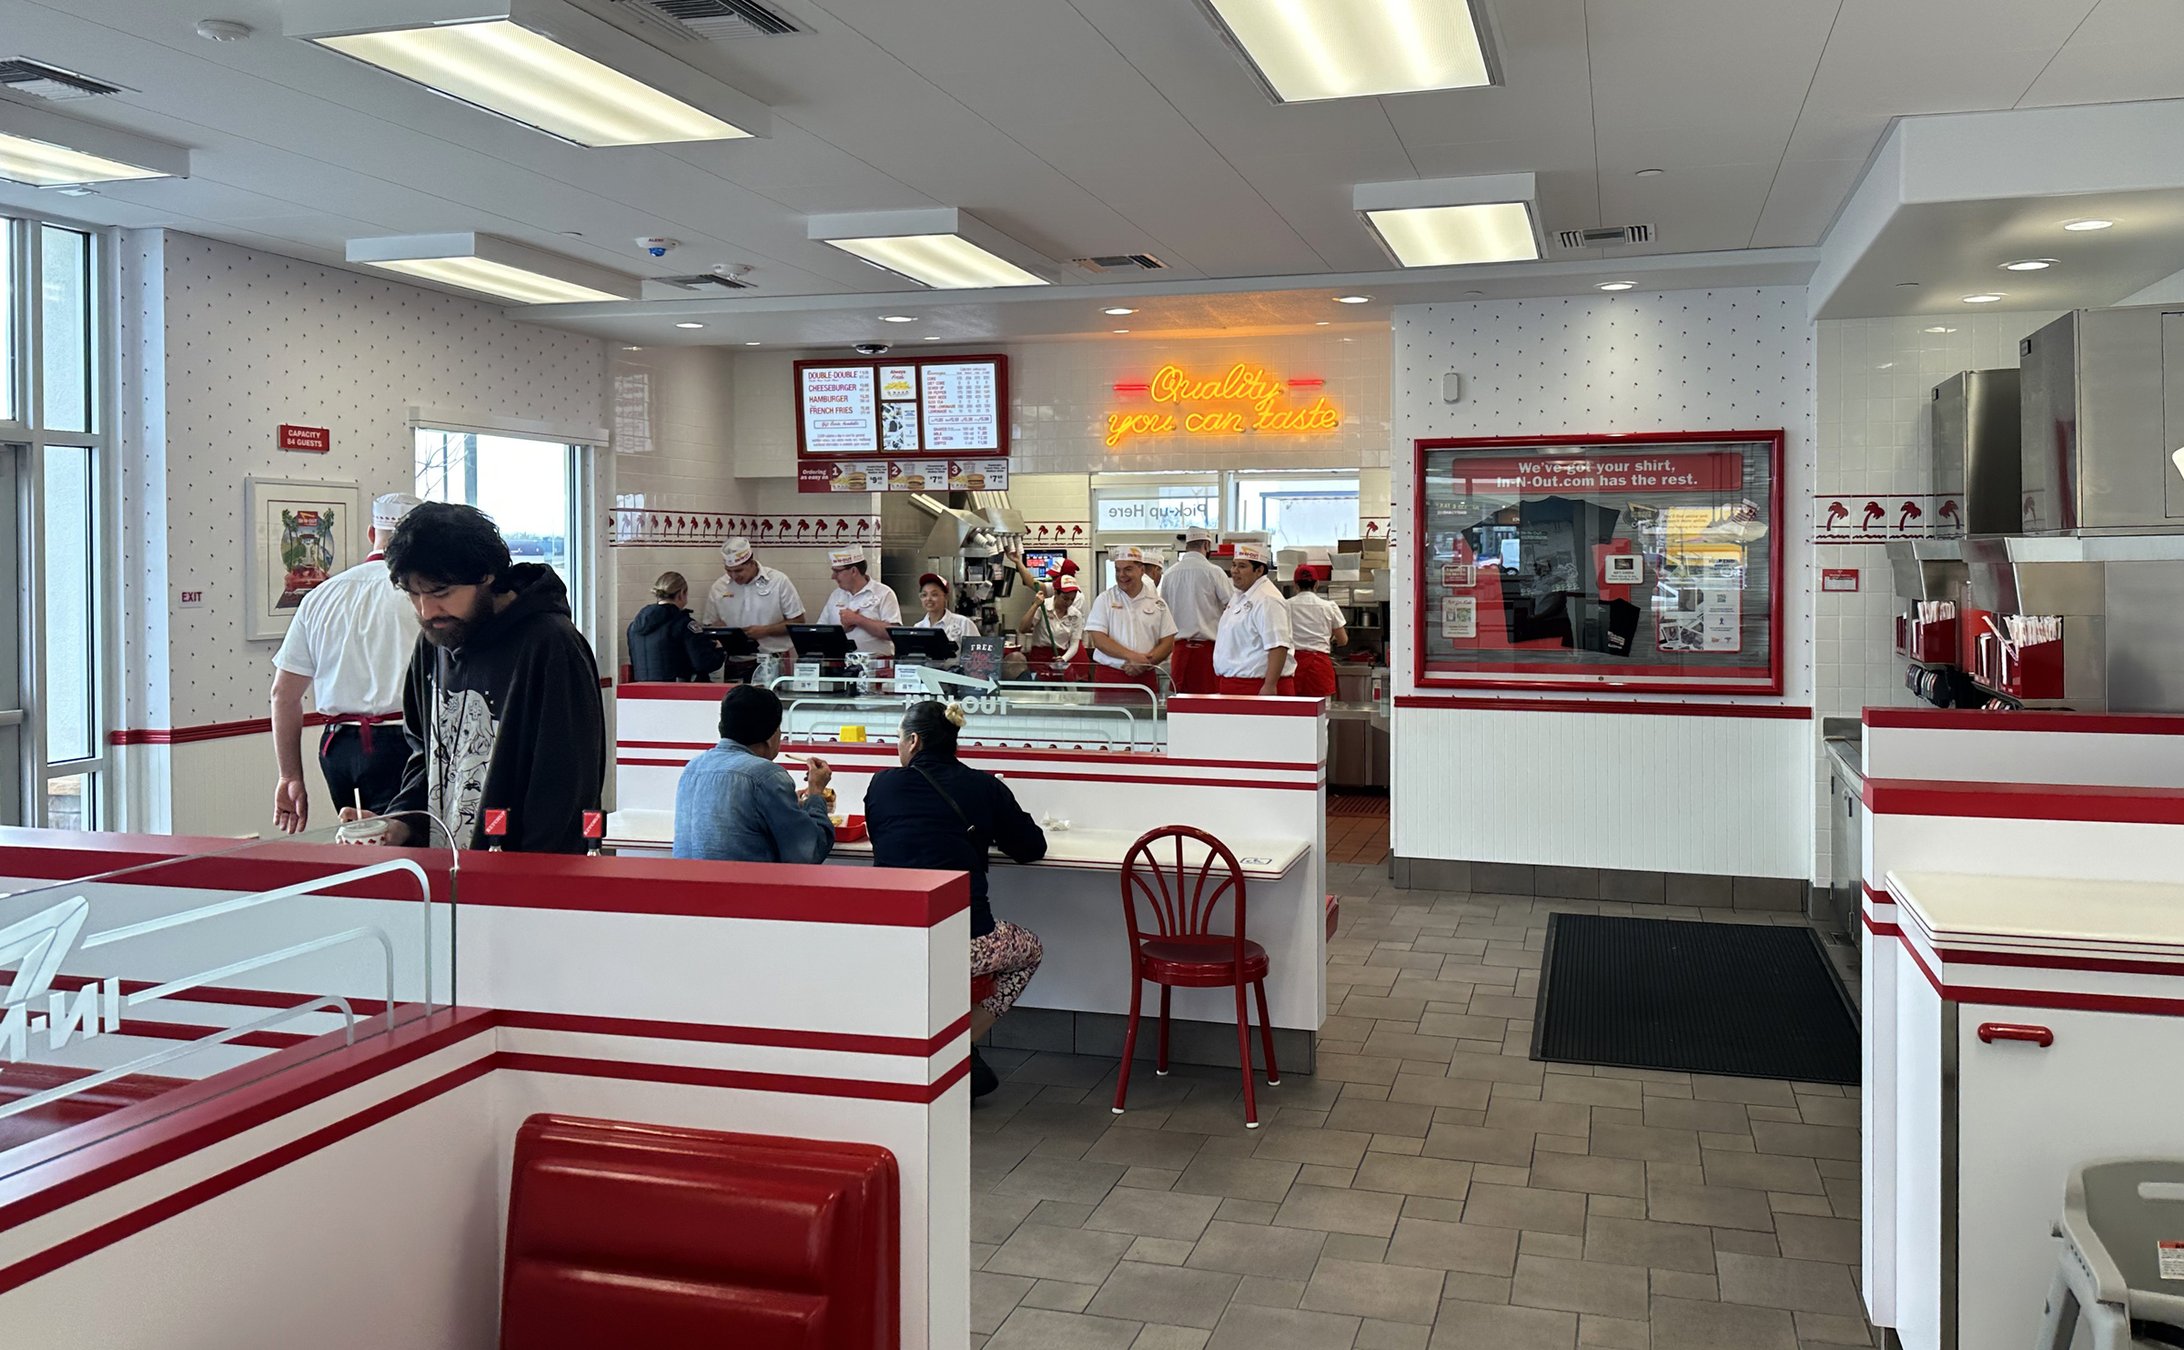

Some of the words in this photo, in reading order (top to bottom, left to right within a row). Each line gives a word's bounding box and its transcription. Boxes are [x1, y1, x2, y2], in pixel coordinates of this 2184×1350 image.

[808, 371, 858, 380] DOUBLE-DOUBLE
[808, 383, 857, 392] CHEESEBURGER
[1151, 363, 1280, 411] Quality
[809, 395, 849, 404] HAMBURGER
[809, 407, 834, 415] FRENCH
[835, 406, 853, 415] FRIES
[1106, 413, 1176, 447] you
[1185, 412, 1246, 432] can
[1253, 397, 1339, 430] taste
[288, 429, 321, 439] CAPACITY
[296, 438, 322, 448] GUESTS
[832, 466, 839, 476] 1
[891, 466, 898, 476] 2
[951, 465, 958, 475] 3
[1518, 461, 1562, 474] We've
[1567, 462, 1592, 475] got
[1596, 461, 1630, 475] your
[1634, 459, 1676, 473] shirt,
[1496, 475, 1595, 488] In-N-Out.com
[1600, 475, 1627, 486] has
[1631, 474, 1657, 486] the
[1661, 473, 1698, 486] rest.
[181, 591, 203, 602] EXIT
[970, 643, 993, 652] FREE
